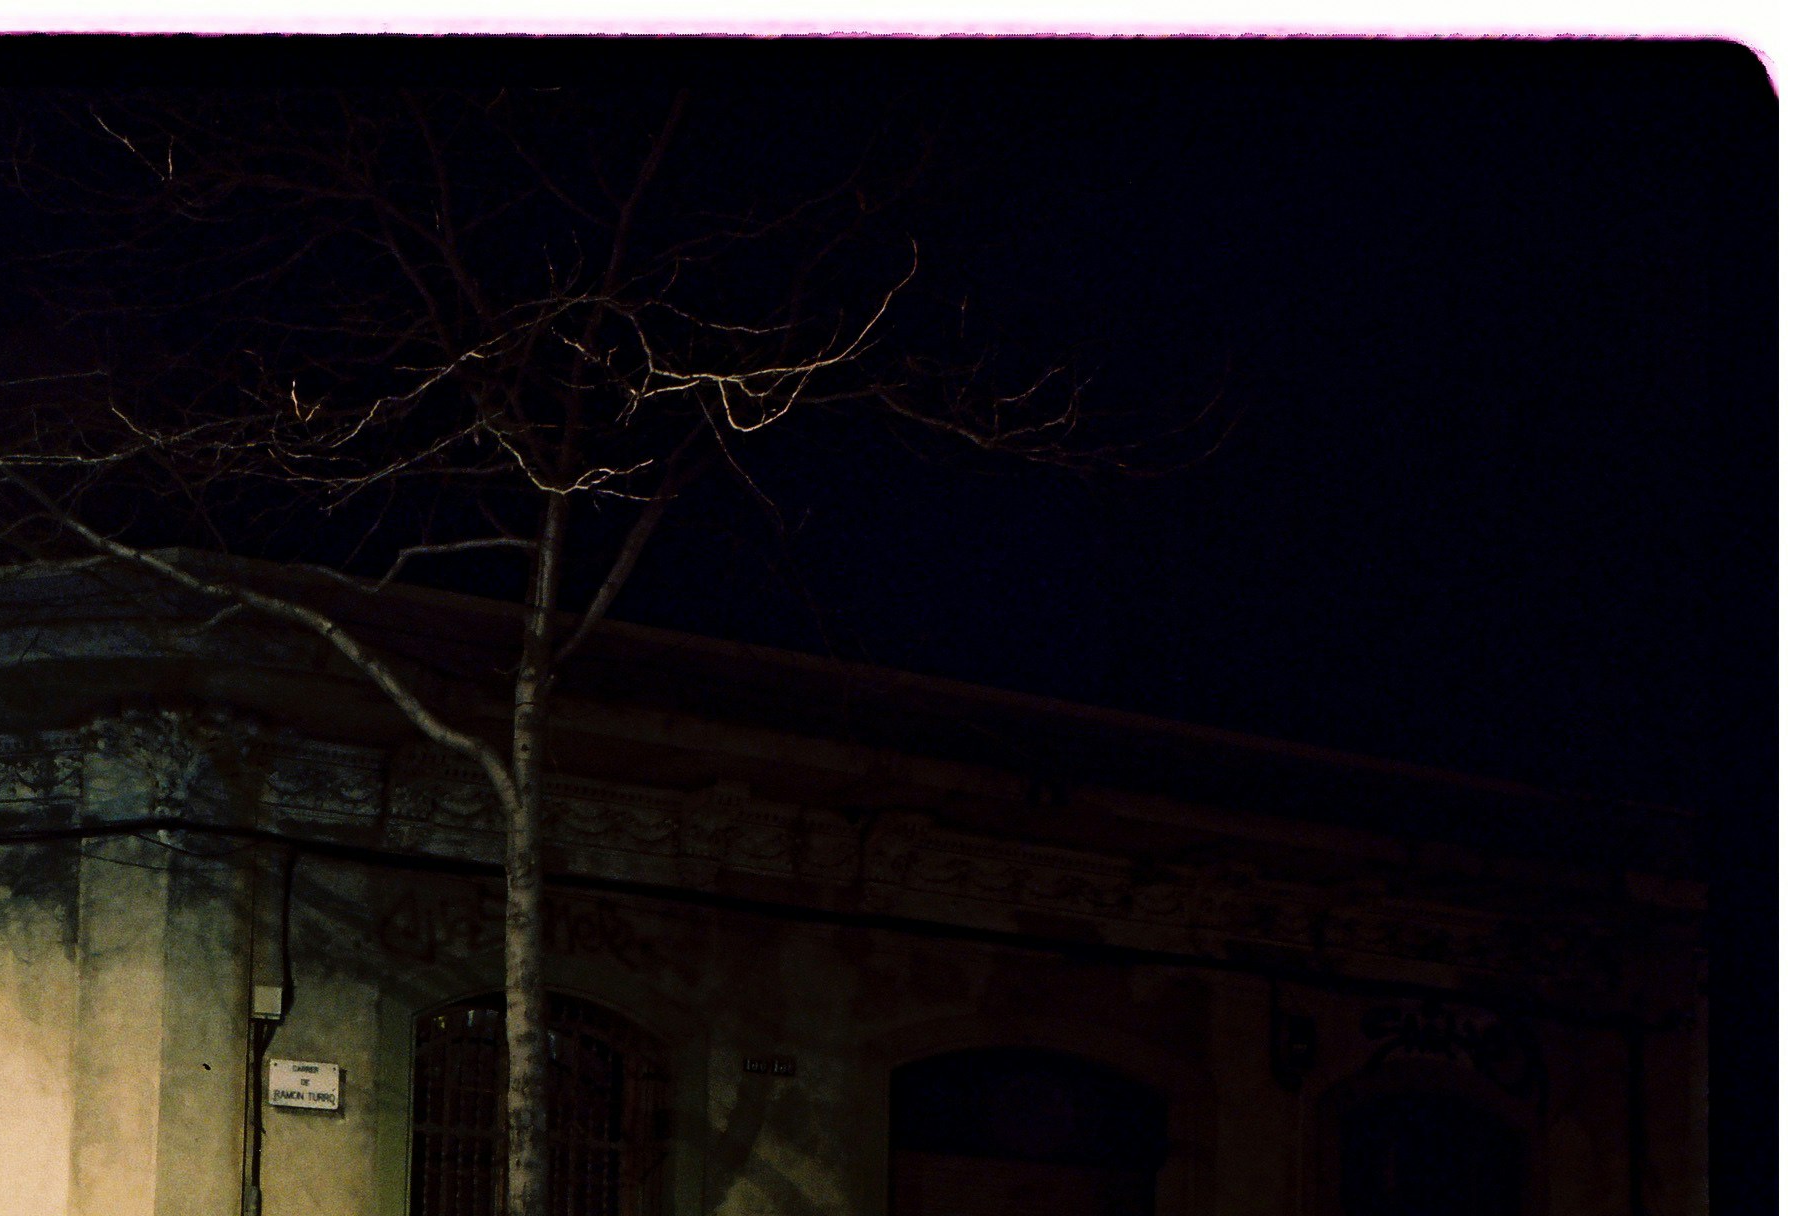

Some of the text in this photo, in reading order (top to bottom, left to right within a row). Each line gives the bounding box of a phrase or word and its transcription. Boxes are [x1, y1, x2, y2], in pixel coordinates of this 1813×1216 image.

[292, 1065, 319, 1074] CARRER
[300, 1078, 310, 1087] DE
[273, 1089, 304, 1102] RAMON
